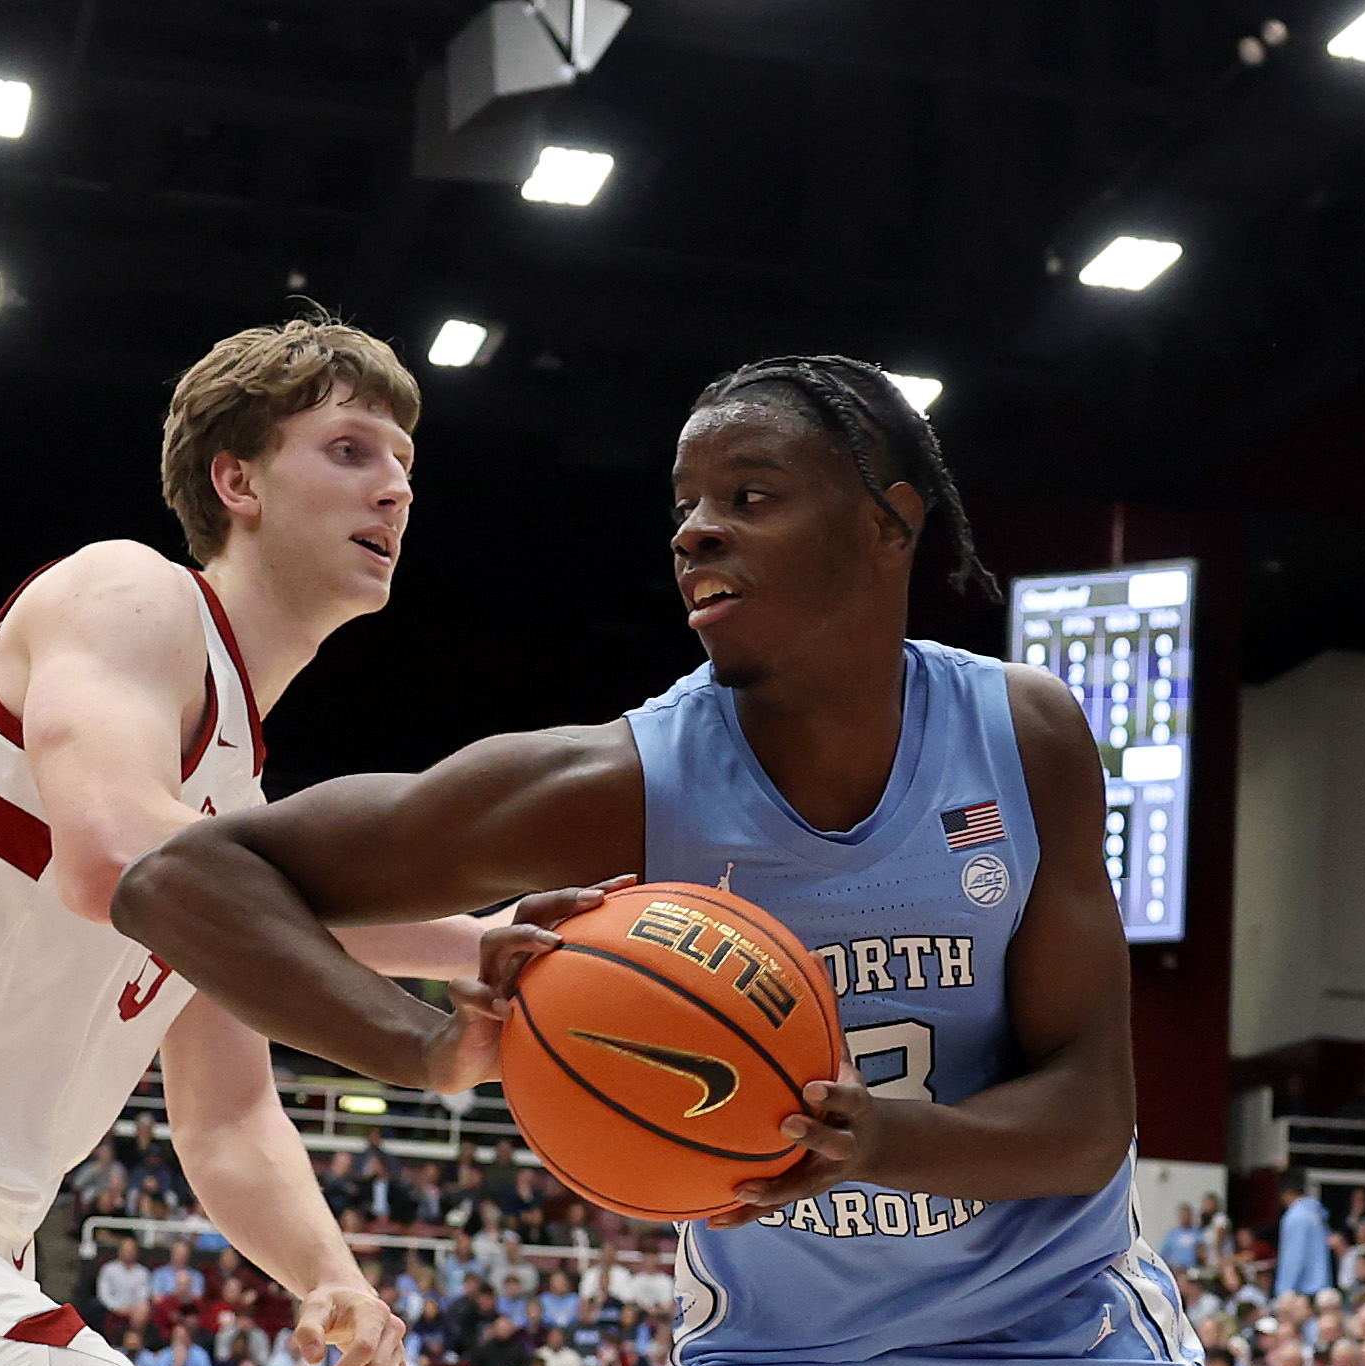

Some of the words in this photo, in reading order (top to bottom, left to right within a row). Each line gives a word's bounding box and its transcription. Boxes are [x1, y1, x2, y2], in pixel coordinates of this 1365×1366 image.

[626, 906, 804, 1031] ELITE
[812, 935, 975, 998] ORTH
[757, 1190, 992, 1238] AROLI
